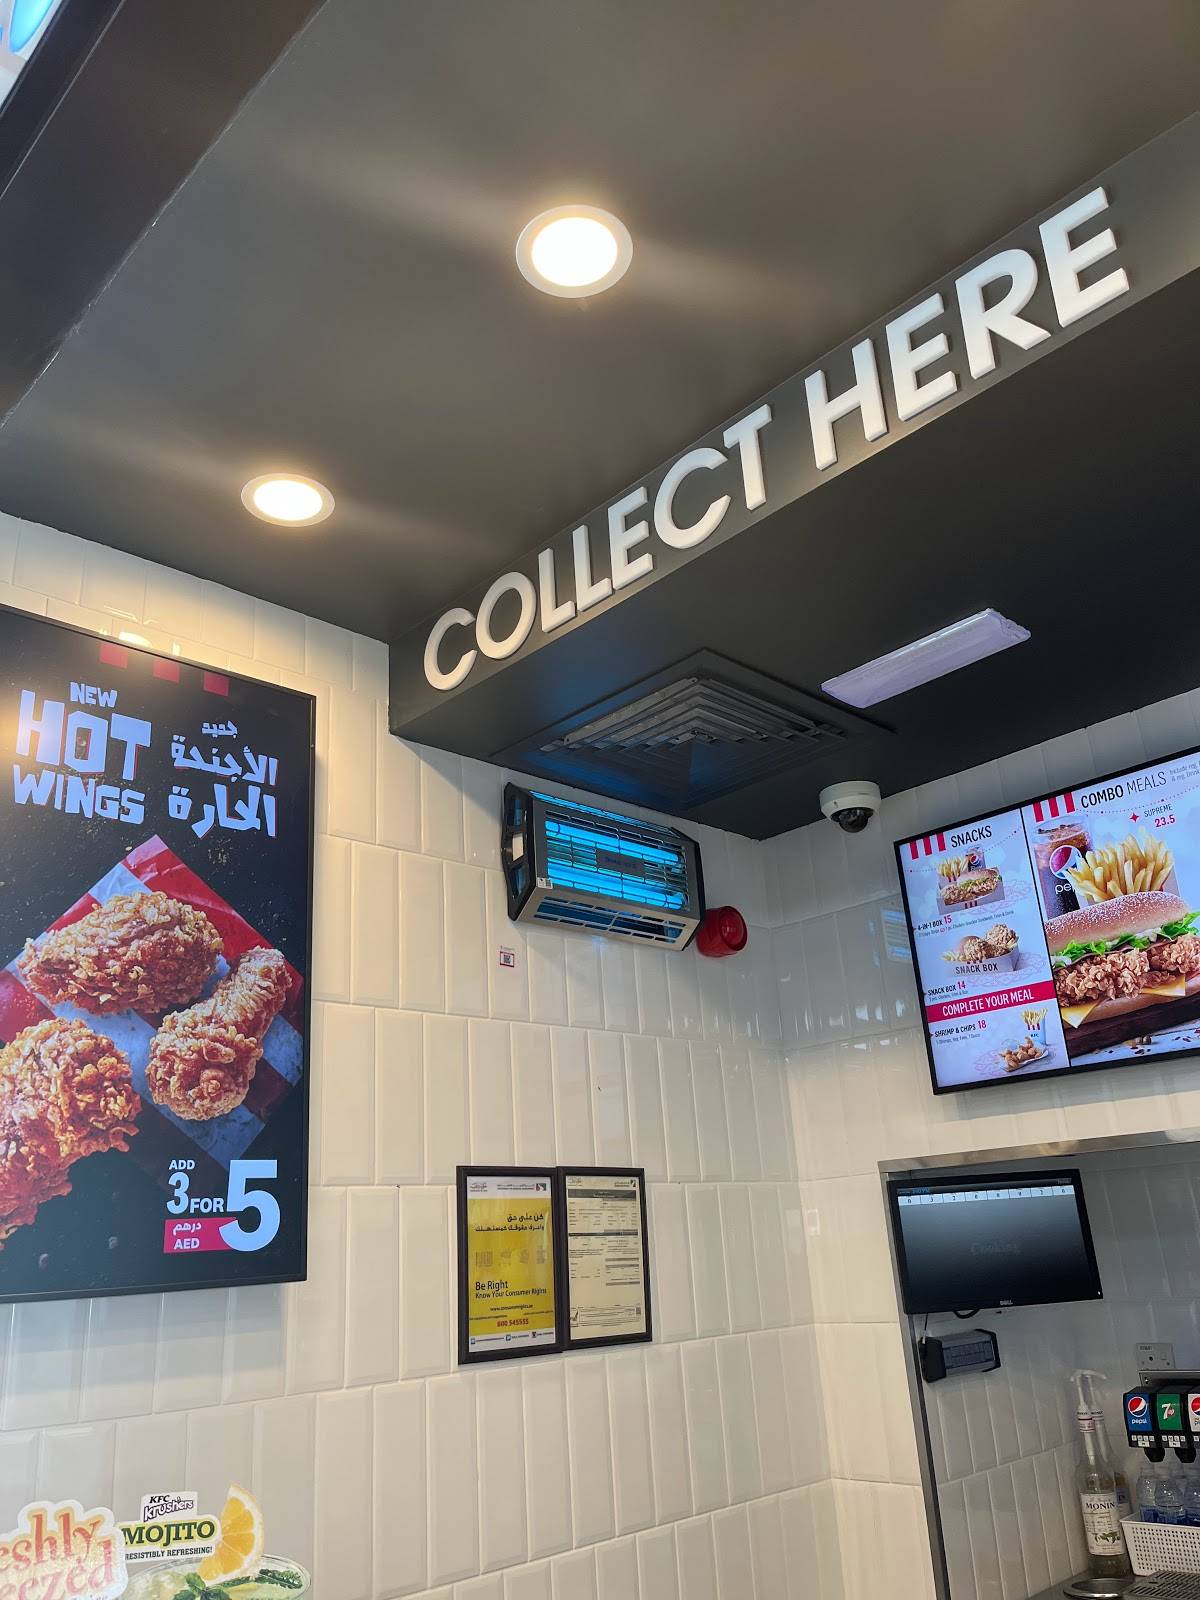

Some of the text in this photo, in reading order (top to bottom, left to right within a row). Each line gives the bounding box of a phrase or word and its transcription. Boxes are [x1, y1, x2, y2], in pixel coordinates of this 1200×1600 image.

[424, 186, 1131, 692] COLLECT HERE
[69, 681, 118, 708] NEW
[15, 689, 152, 782] HOT
[201, 719, 239, 739] جديد
[12, 764, 146, 825] WINGS
[1080, 771, 1167, 809] COMBO MEALS
[167, 783, 278, 839] الحارة
[1143, 803, 1173, 818] SUPREME
[1154, 814, 1176, 828] 23.5
[950, 825, 992, 848] SNACKS
[1055, 883, 1075, 895] pe
[943, 914, 952, 924] 15
[955, 963, 999, 975] SNACK BOX
[928, 986, 945, 996] SNACK
[945, 984, 957, 993] BOX
[957, 980, 966, 990] 14
[942, 998, 985, 1016] COMPLETE
[985, 995, 1010, 1008] YOUR
[1010, 988, 1034, 1002] MEAL
[934, 1028, 955, 1038] SHRIMP
[960, 1023, 976, 1033] CHIPS
[977, 1019, 987, 1030] 18
[168, 1159, 196, 1170] ADD
[166, 1159, 281, 1252] 3 FOR 5
[172, 1221, 202, 1236] درهم
[173, 1237, 200, 1250] AED
[475, 1279, 509, 1292] Be Right
[475, 1286, 547, 1299] Know Your Consumer Rights
[149, 1495, 170, 1504] KFC
[1085, 1502, 1116, 1510] MONIN
[120, 1520, 215, 1547] MOJITO
[124, 1545, 213, 1561] RESISTIBLY REFRESHING!
